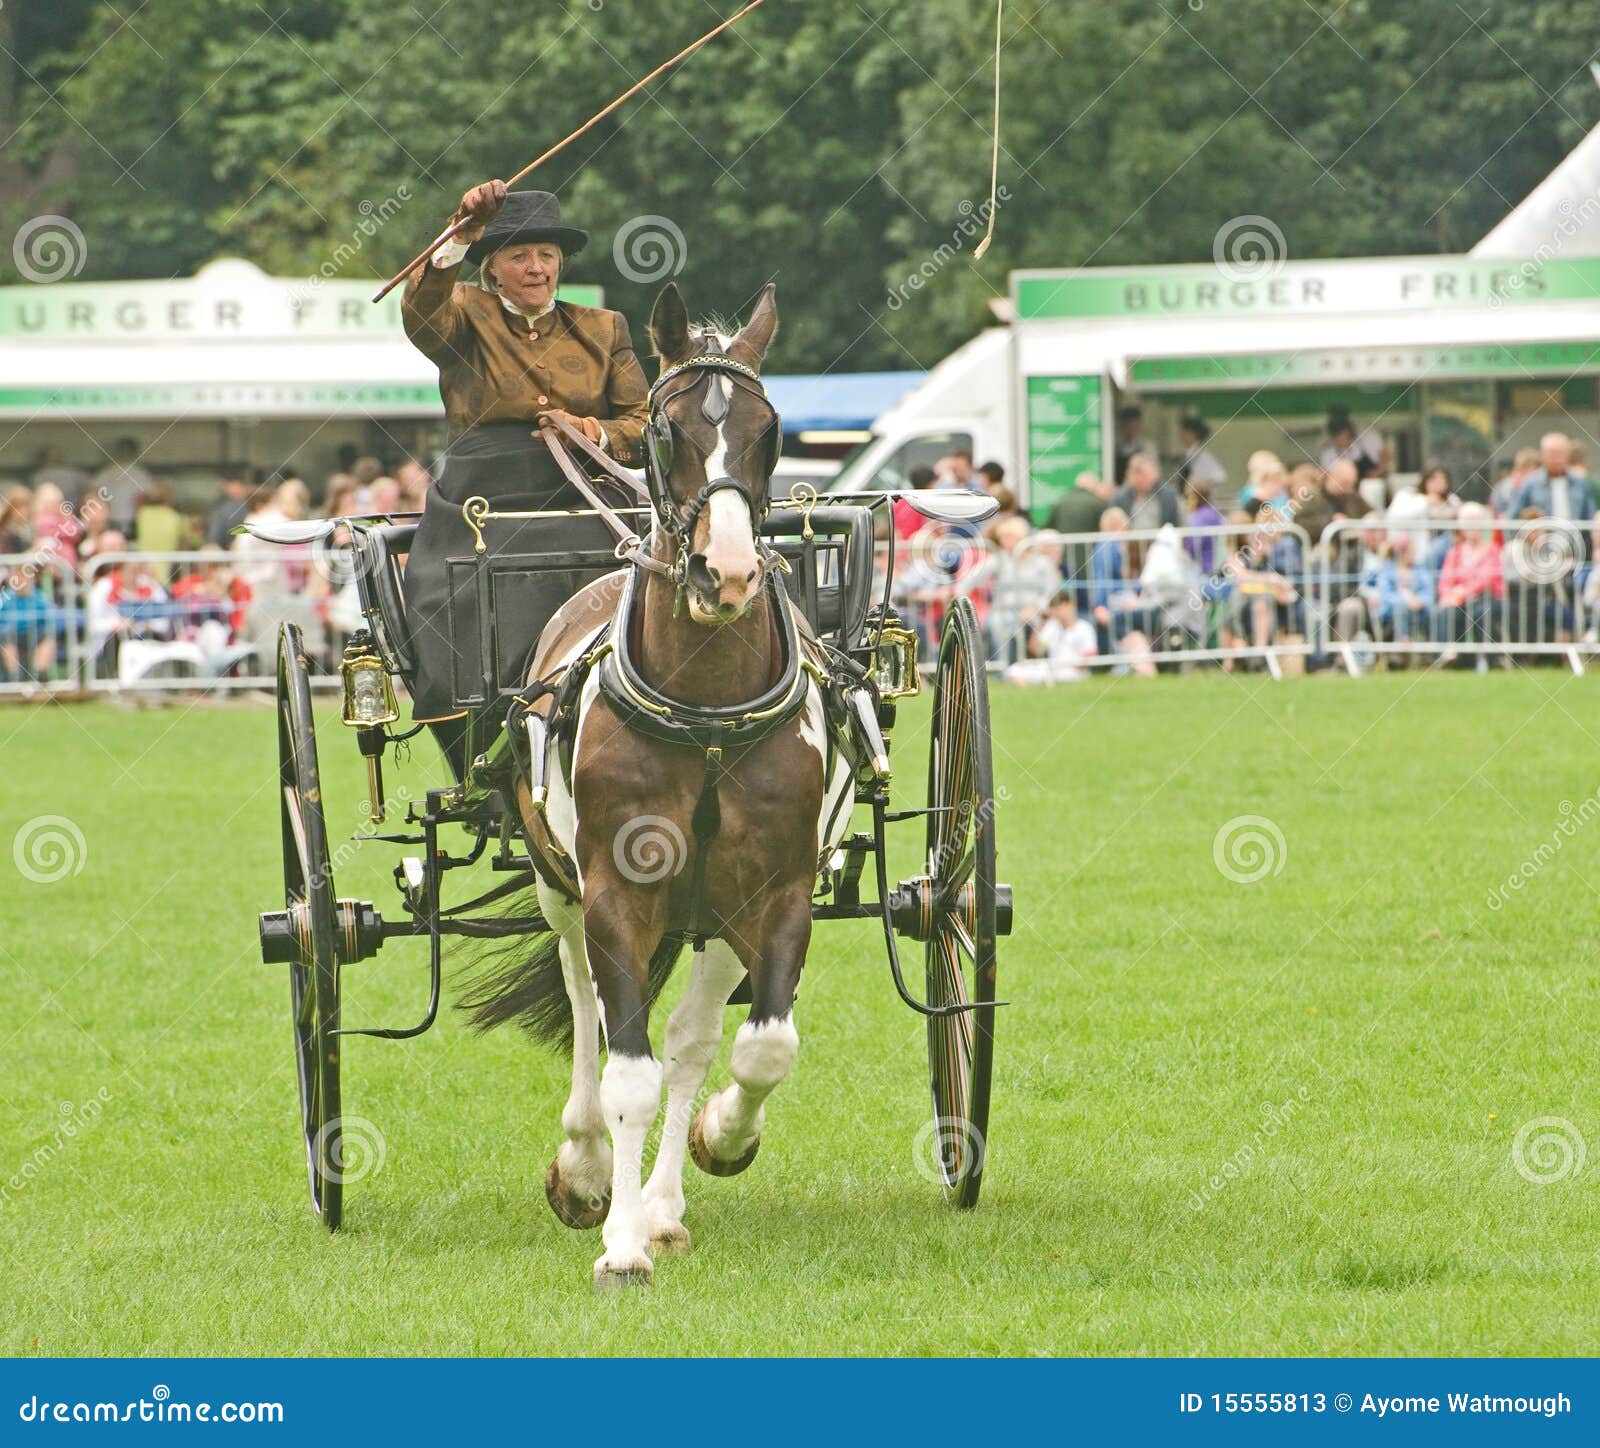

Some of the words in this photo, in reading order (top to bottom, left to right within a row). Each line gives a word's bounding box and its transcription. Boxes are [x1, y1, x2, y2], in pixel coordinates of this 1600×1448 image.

[1124, 277, 1326, 310] BURGER
[1401, 268, 1547, 300] FRIES
[15, 299, 243, 333] URGER
[292, 298, 399, 328] FRI
